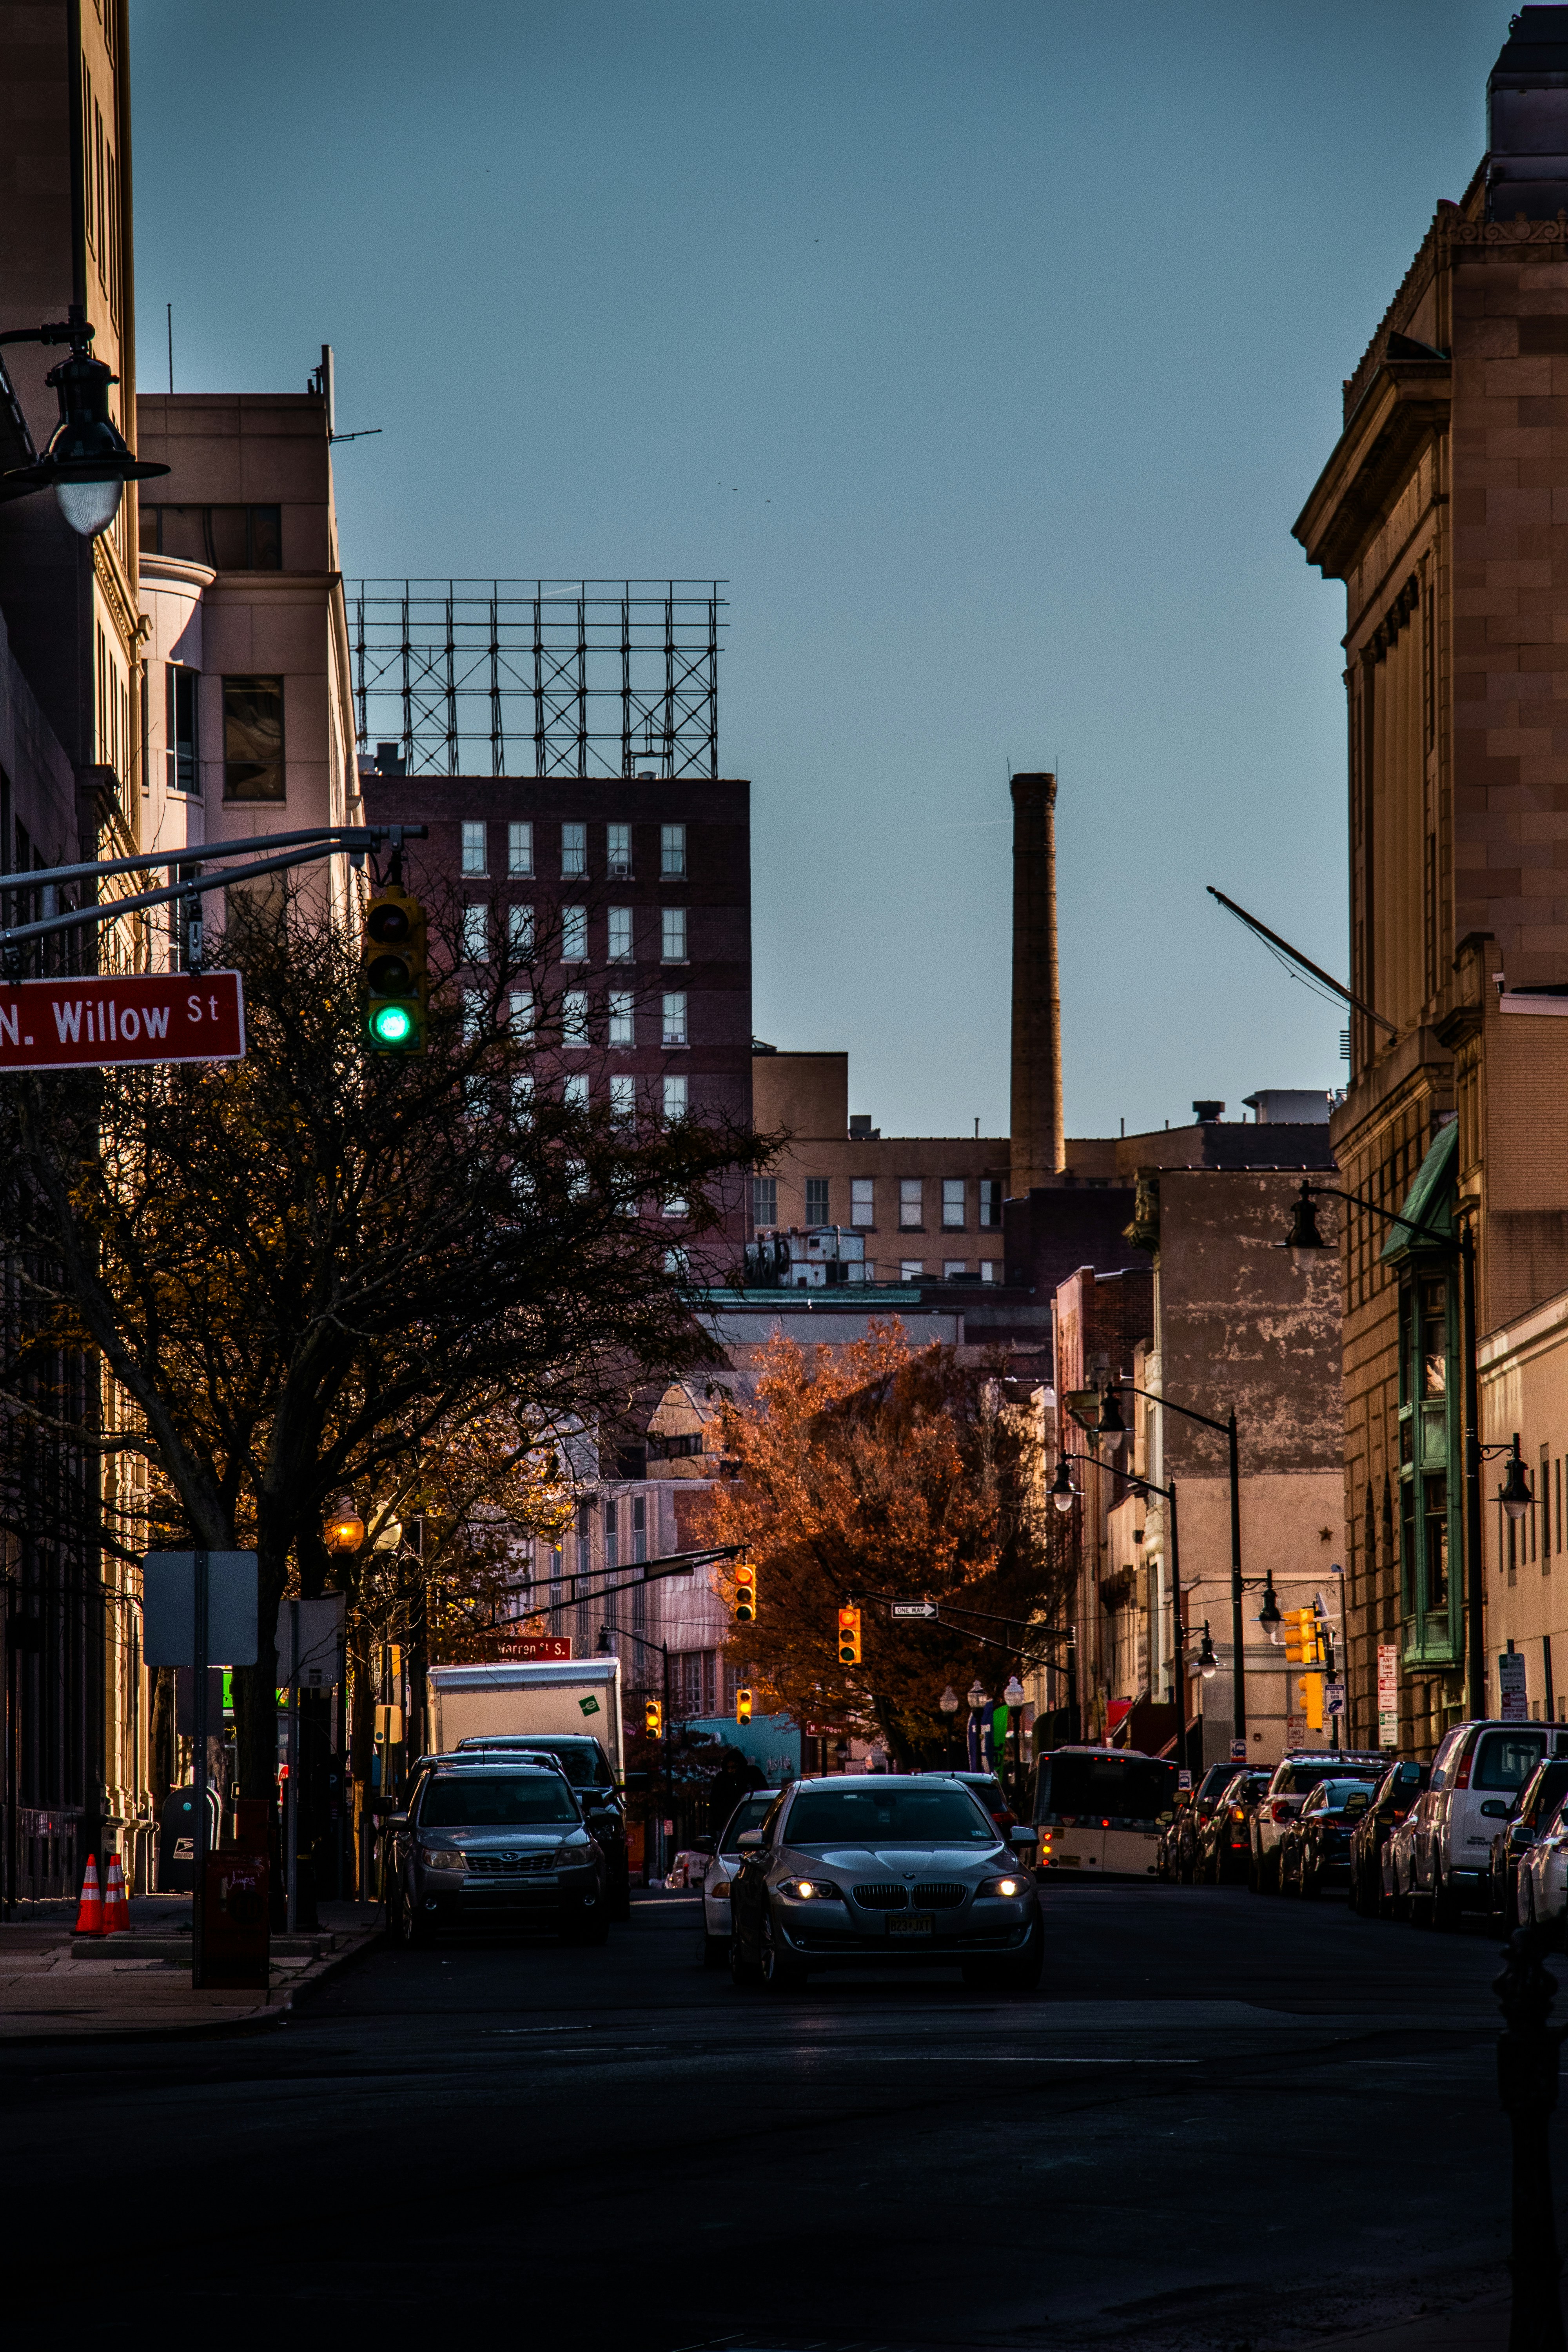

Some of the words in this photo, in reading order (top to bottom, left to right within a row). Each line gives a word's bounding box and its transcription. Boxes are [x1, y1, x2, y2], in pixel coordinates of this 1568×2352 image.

[52, 1000, 170, 1043] Willow
[187, 995, 219, 1022] St
[554, 1642, 566, 1655] S.
[890, 1920, 907, 1931] B23
[914, 1920, 930, 1931] JXT
